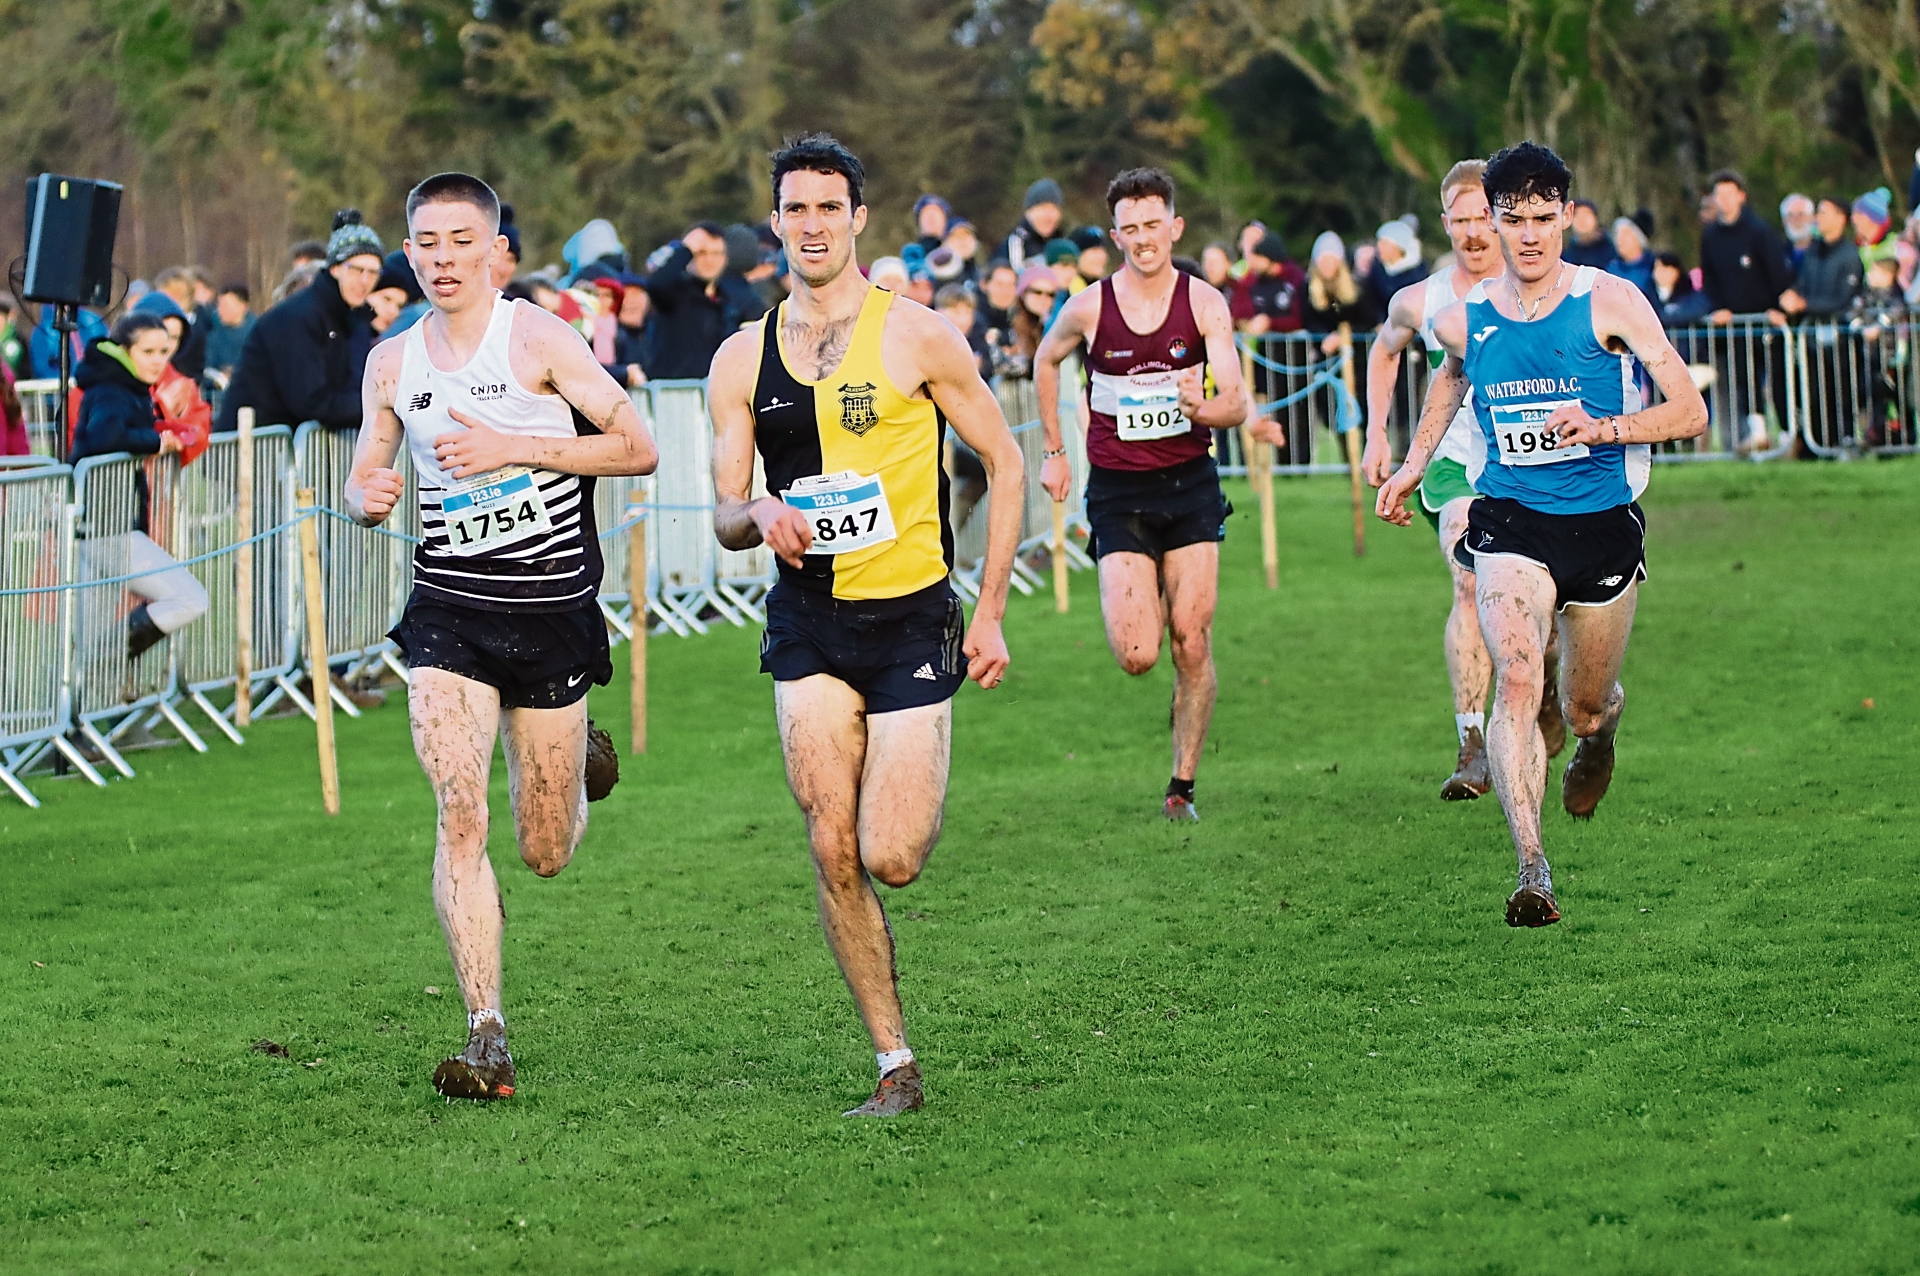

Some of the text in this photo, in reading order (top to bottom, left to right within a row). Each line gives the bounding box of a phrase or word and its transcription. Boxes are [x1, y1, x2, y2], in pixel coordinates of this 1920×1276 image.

[1127, 361, 1173, 376] MULLINGAR
[1485, 377, 1582, 400] WATERFORD A.C.
[1125, 407, 1184, 429] 1902
[1503, 430, 1577, 454] 198
[467, 487, 502, 504] 123.ie
[812, 493, 849, 508] 123.ie
[455, 500, 537, 545] 1754
[805, 506, 879, 542] 847
